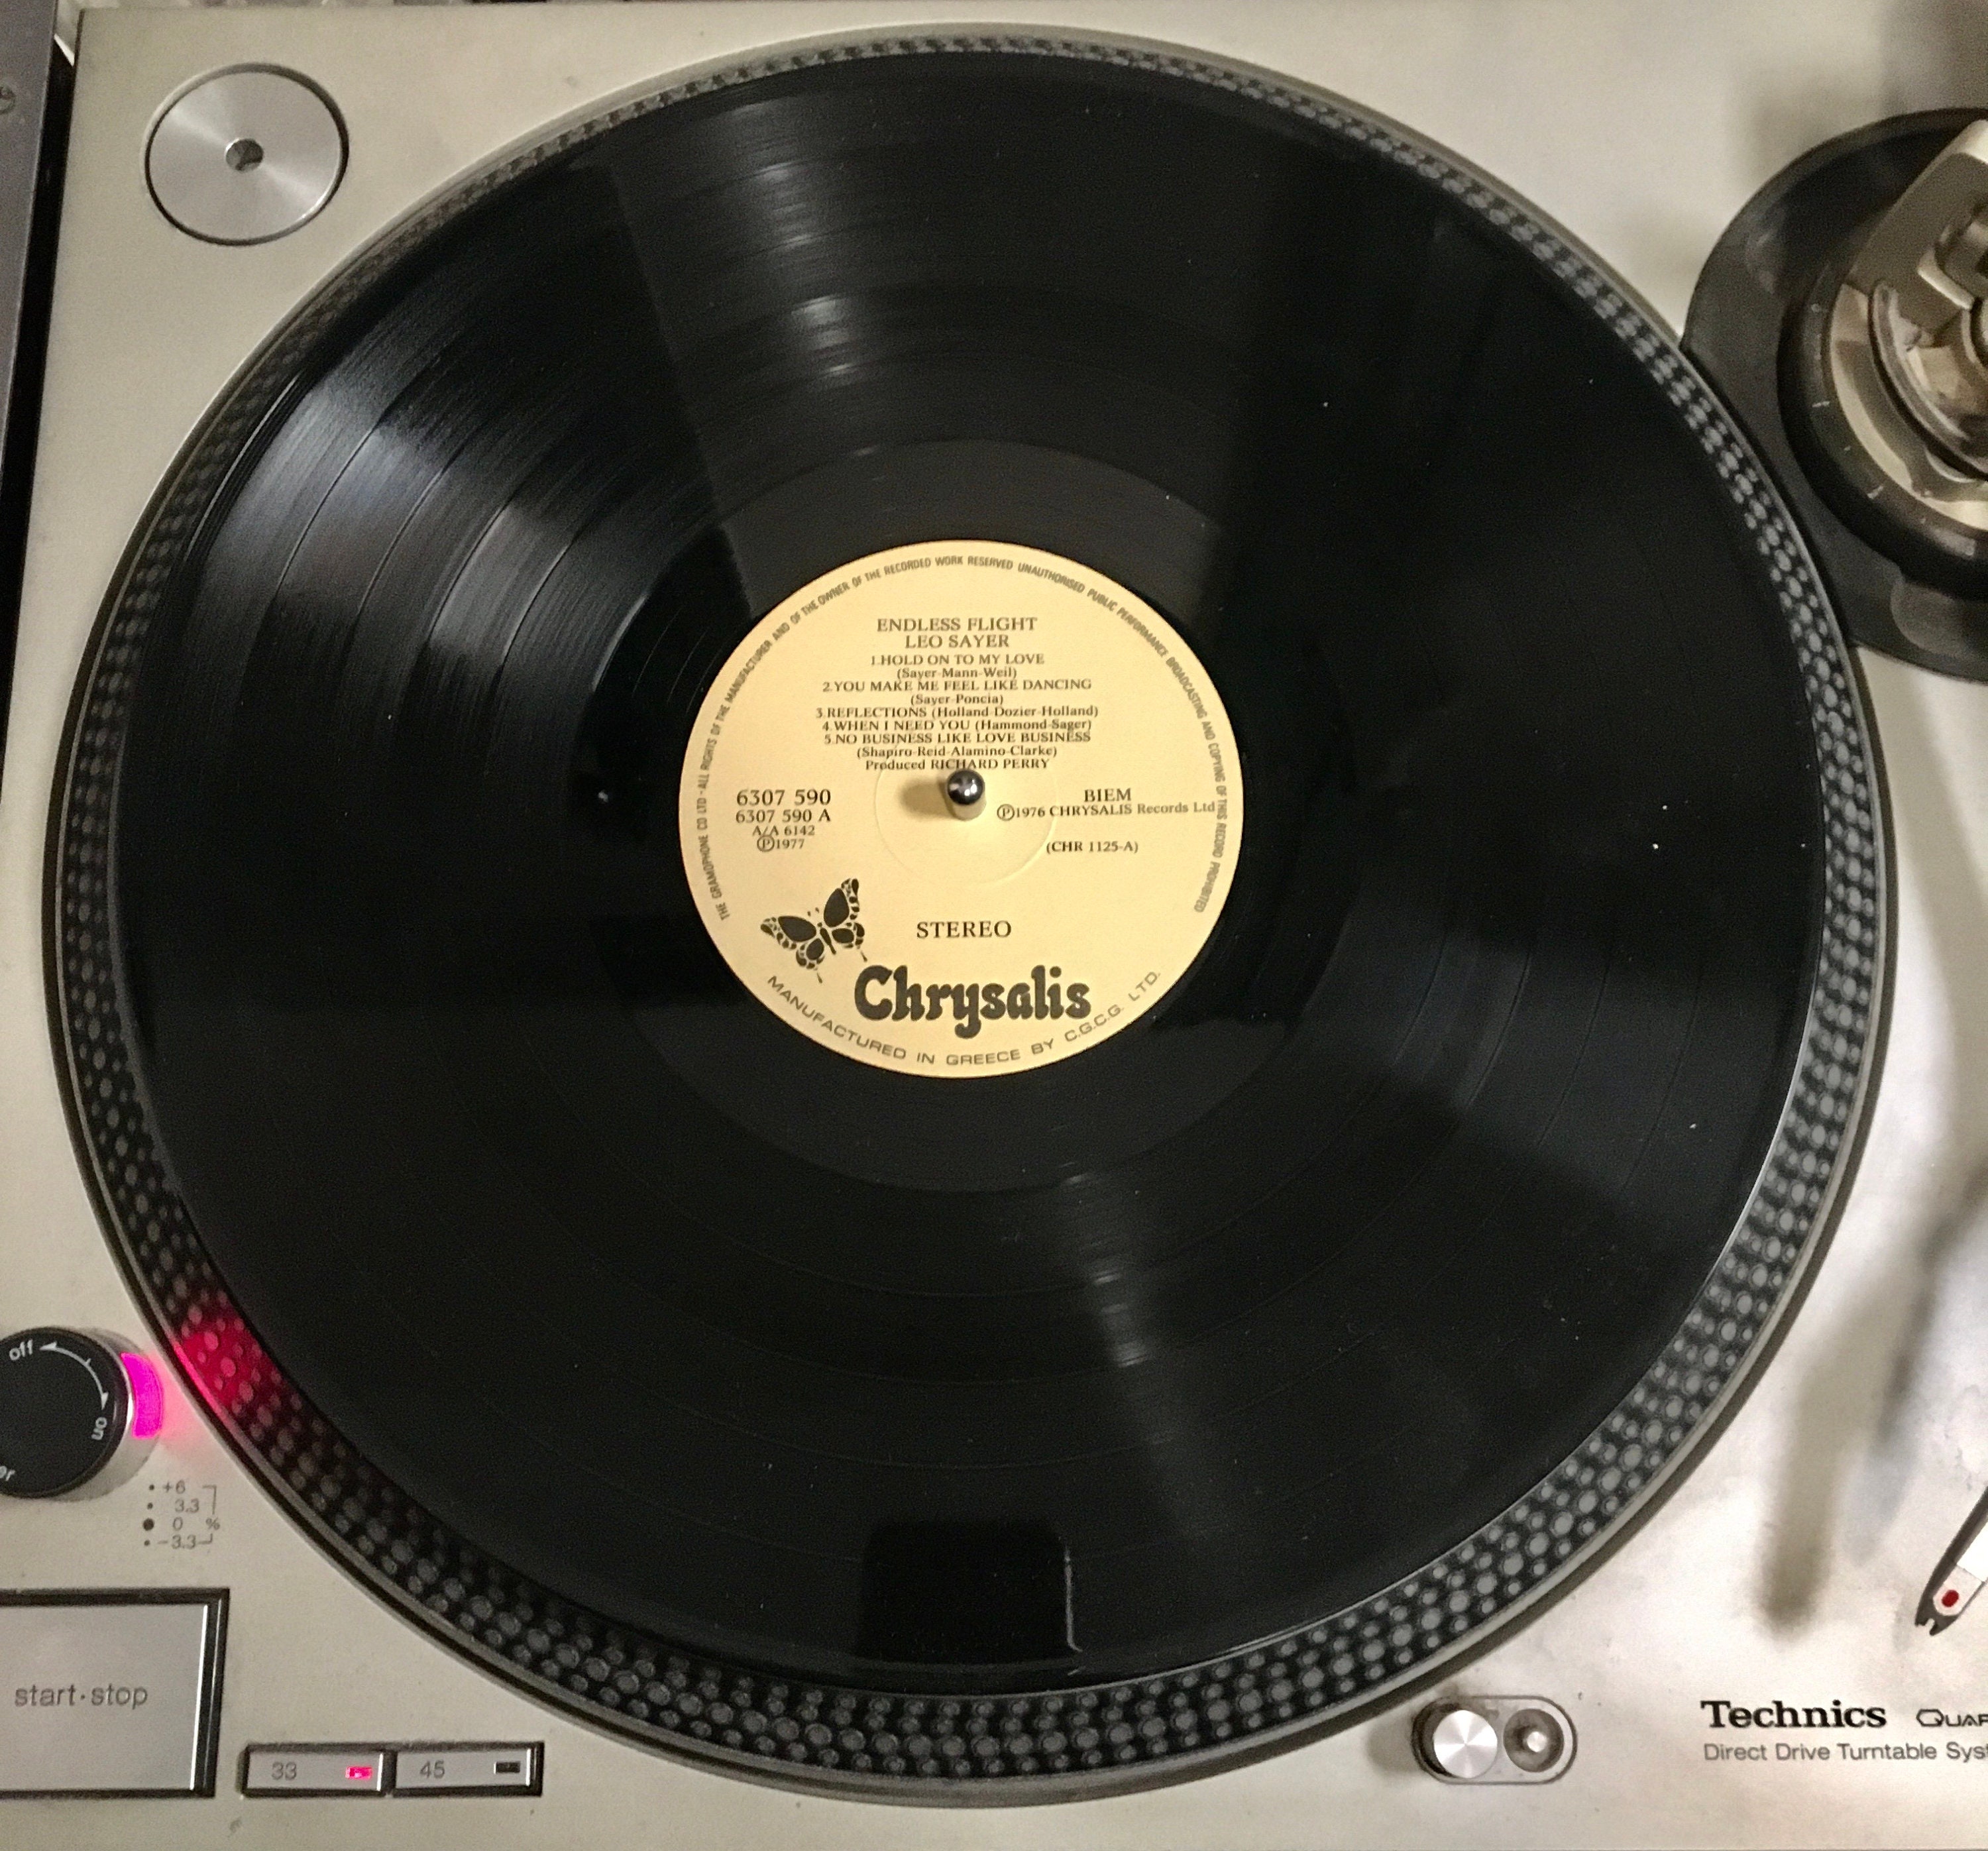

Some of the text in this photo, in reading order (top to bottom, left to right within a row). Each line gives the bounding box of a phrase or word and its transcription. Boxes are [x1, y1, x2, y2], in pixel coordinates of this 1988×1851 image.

[877, 617, 1038, 632] ENDLESS FLIGHT
[905, 634, 1009, 648] LEO SAYER
[927, 654, 949, 665] ON
[954, 654, 974, 665] TO
[979, 653, 1001, 664] MY
[1006, 653, 1044, 664] LOVE
[870, 681, 912, 692] MAKE
[918, 681, 939, 691] ME
[944, 680, 979, 691] FEEL
[984, 680, 1018, 690] LIKE
[1023, 679, 1091, 690] DANCING
[885, 720, 888, 730] I
[894, 720, 934, 730] NEED
[940, 720, 969, 730] YOU
[863, 733, 932, 744] BUSINESS
[938, 732, 971, 743] LIKE
[976, 732, 1016, 743] LOVE
[1021, 732, 1091, 742] BUSINESS
[865, 758, 1050, 770] Produced RICHARD PERRY
[736, 789, 831, 806] 6307 590
[1083, 788, 1132, 803] BIEM
[736, 808, 831, 823] 6307 590 A
[1049, 803, 1132, 817] CHRYSALIS
[1137, 801, 1189, 814] Records
[1193, 801, 1215, 813] Ltd
[752, 825, 815, 836] A/A 6142
[1046, 840, 1138, 854] (CHR 1125-A)
[916, 920, 1012, 938] STEREO
[854, 964, 1091, 1039] Chrysalis
[767, 976, 907, 1059] MANUFACTURED
[916, 1052, 936, 1064] IN
[946, 1049, 1021, 1066] GREECE
[1030, 1038, 1054, 1055] BY
[9, 1339, 33, 1361] off
[91, 1417, 107, 1440] on
[174, 1498, 199, 1513] 3.3
[172, 1516, 220, 1531] 0 %
[1700, 1699, 1887, 1728] Technics
[1704, 1741, 1988, 1763] Direct Drive Turntable Sys
[271, 1762, 298, 1780] 33
[419, 1760, 445, 1778] 45
